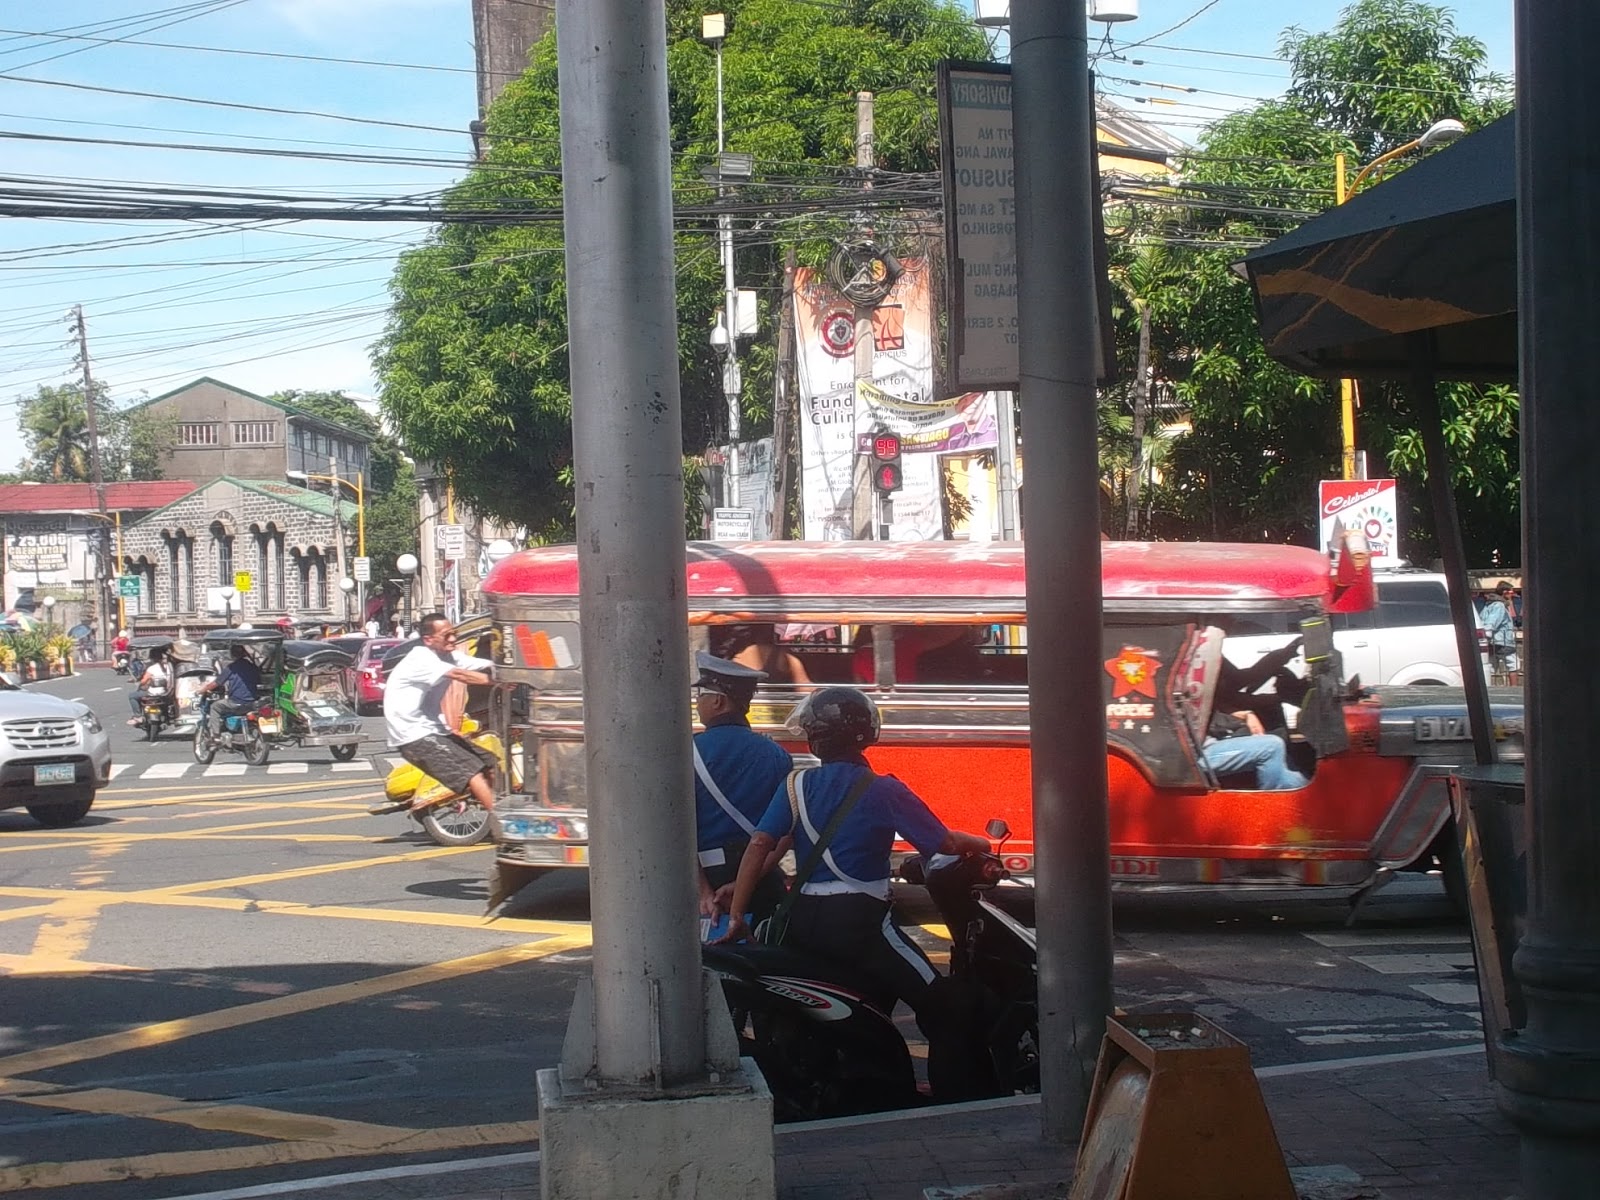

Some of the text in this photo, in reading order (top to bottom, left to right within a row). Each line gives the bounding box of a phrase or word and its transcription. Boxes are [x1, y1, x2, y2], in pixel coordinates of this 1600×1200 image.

[873, 351, 908, 360] APICIUS
[890, 375, 905, 386] for
[875, 438, 897, 457] 99
